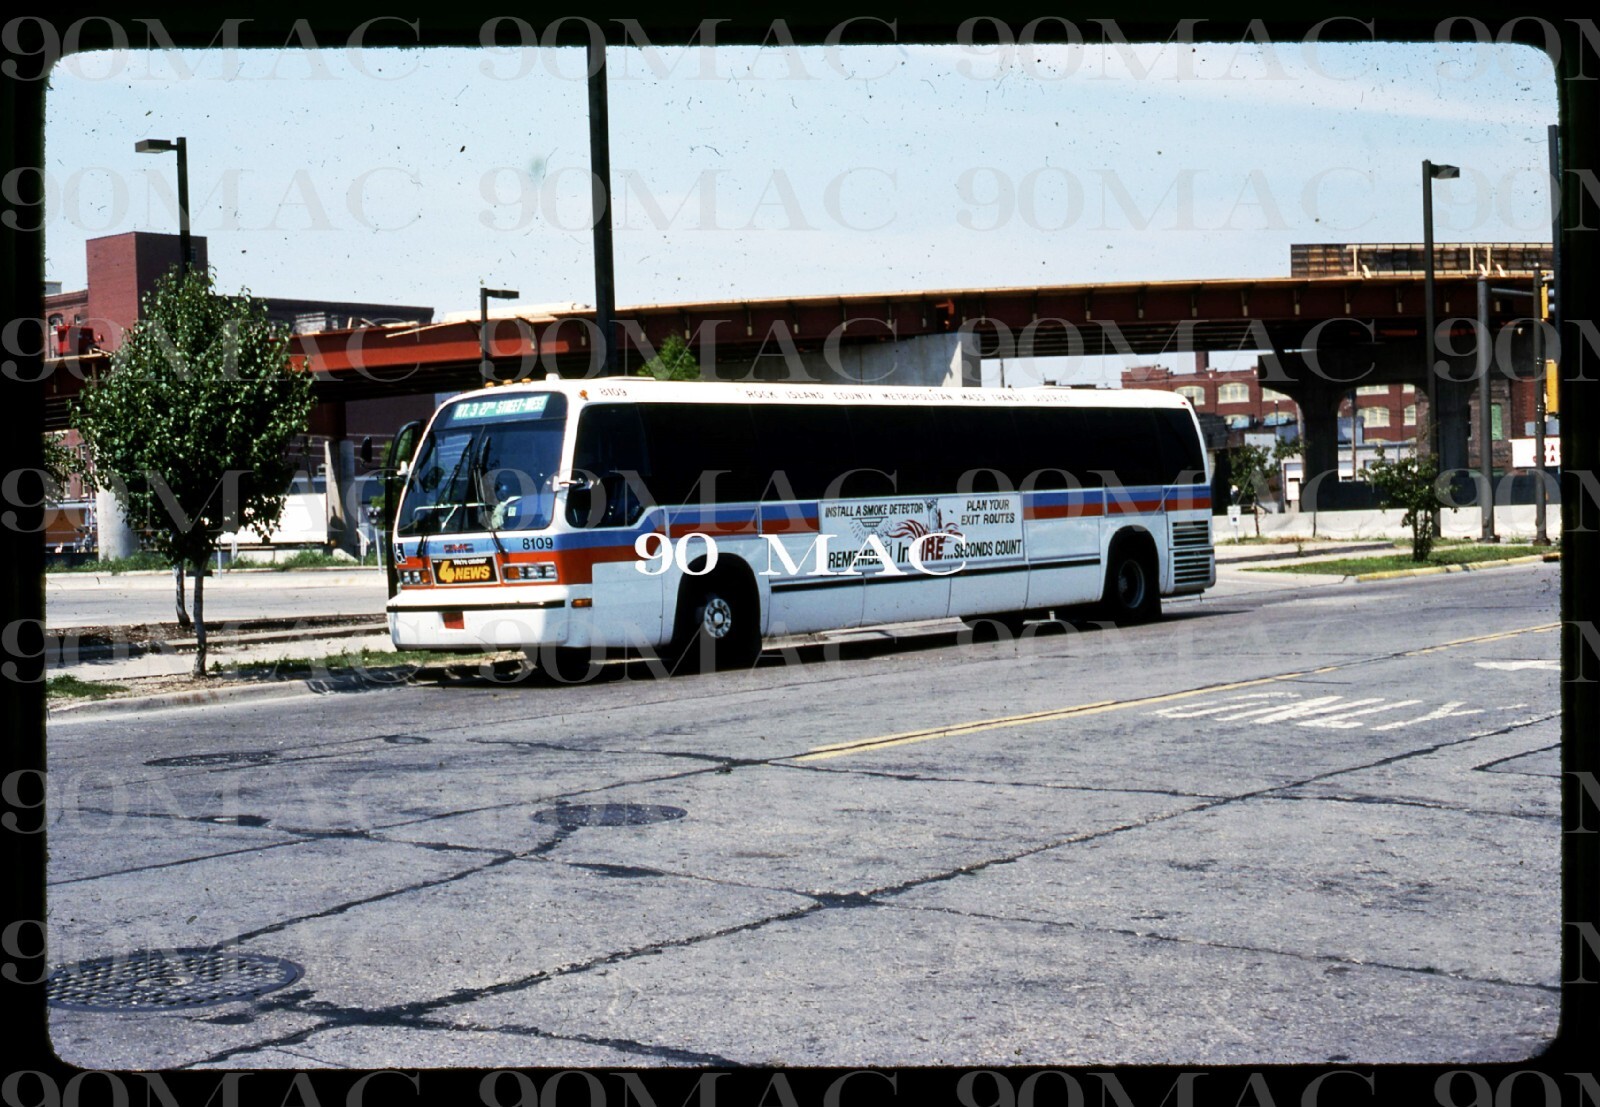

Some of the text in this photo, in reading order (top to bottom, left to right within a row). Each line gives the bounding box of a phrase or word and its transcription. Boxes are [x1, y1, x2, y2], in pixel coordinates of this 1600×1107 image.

[599, 386, 628, 397] 8109
[745, 389, 776, 399] ROCK
[785, 390, 825, 400] ISLAND
[833, 391, 873, 400] COUNTY
[961, 393, 986, 401] MASS
[825, 502, 924, 518] INSTALL A SMOKE DETECTOR
[966, 498, 1010, 512] PLAN YOUR
[960, 512, 1015, 526] EXIT ROUTES
[444, 543, 475, 554] GMC
[522, 537, 553, 550] 8109
[995, 539, 1022, 556] COUNT
[438, 560, 455, 584] 4
[455, 565, 491, 580] NEWS
